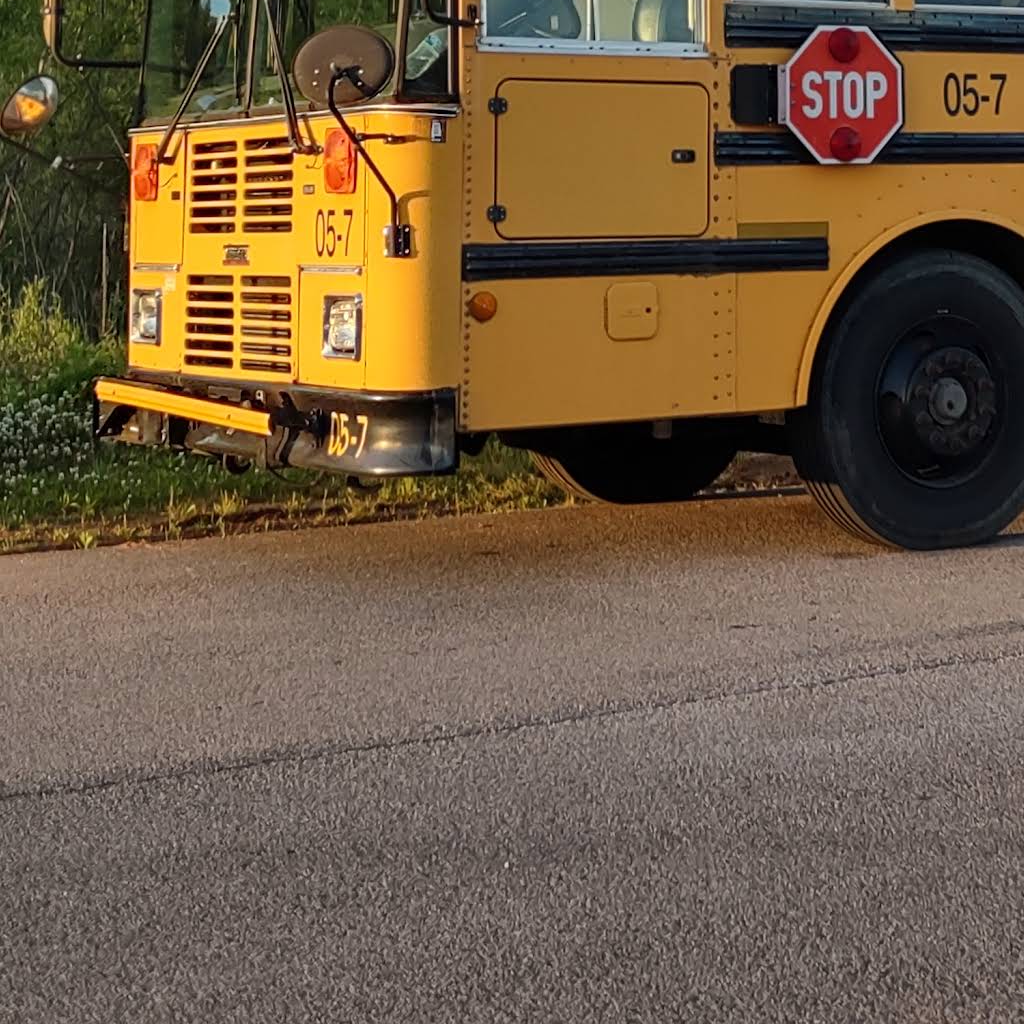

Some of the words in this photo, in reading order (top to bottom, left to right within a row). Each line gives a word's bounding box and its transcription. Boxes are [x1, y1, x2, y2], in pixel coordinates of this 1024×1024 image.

[801, 71, 888, 119] STOP
[943, 72, 1008, 116] 05-7
[315, 209, 353, 258] 05-7
[328, 411, 368, 459] 05-7
